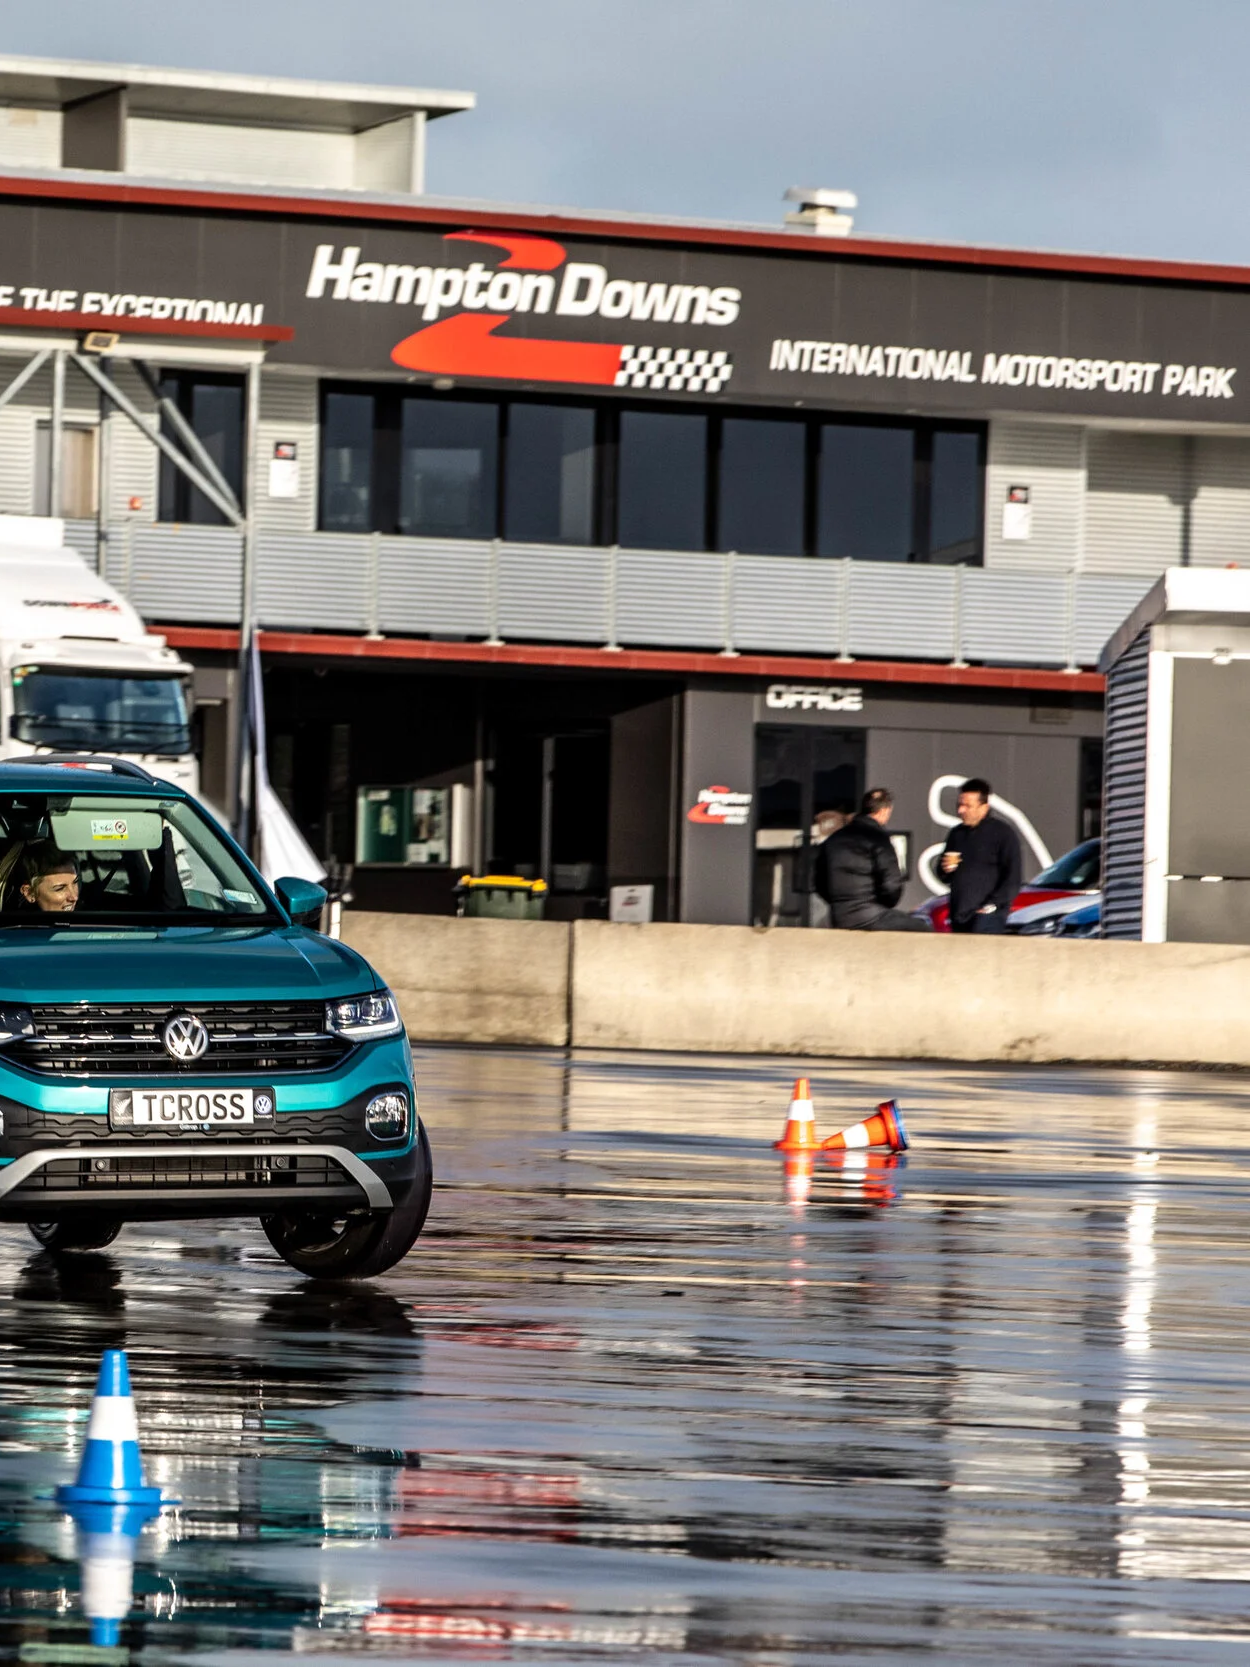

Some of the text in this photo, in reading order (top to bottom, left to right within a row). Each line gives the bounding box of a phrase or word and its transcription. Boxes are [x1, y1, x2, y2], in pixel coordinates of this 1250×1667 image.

[19, 287, 78, 312] THE
[305, 244, 742, 326] Hampton Downs
[769, 339, 1237, 399] INTERNATIONAL MOTORSPORT PARK
[766, 684, 864, 711] OFFICE
[142, 1093, 246, 1122] TCROSS
